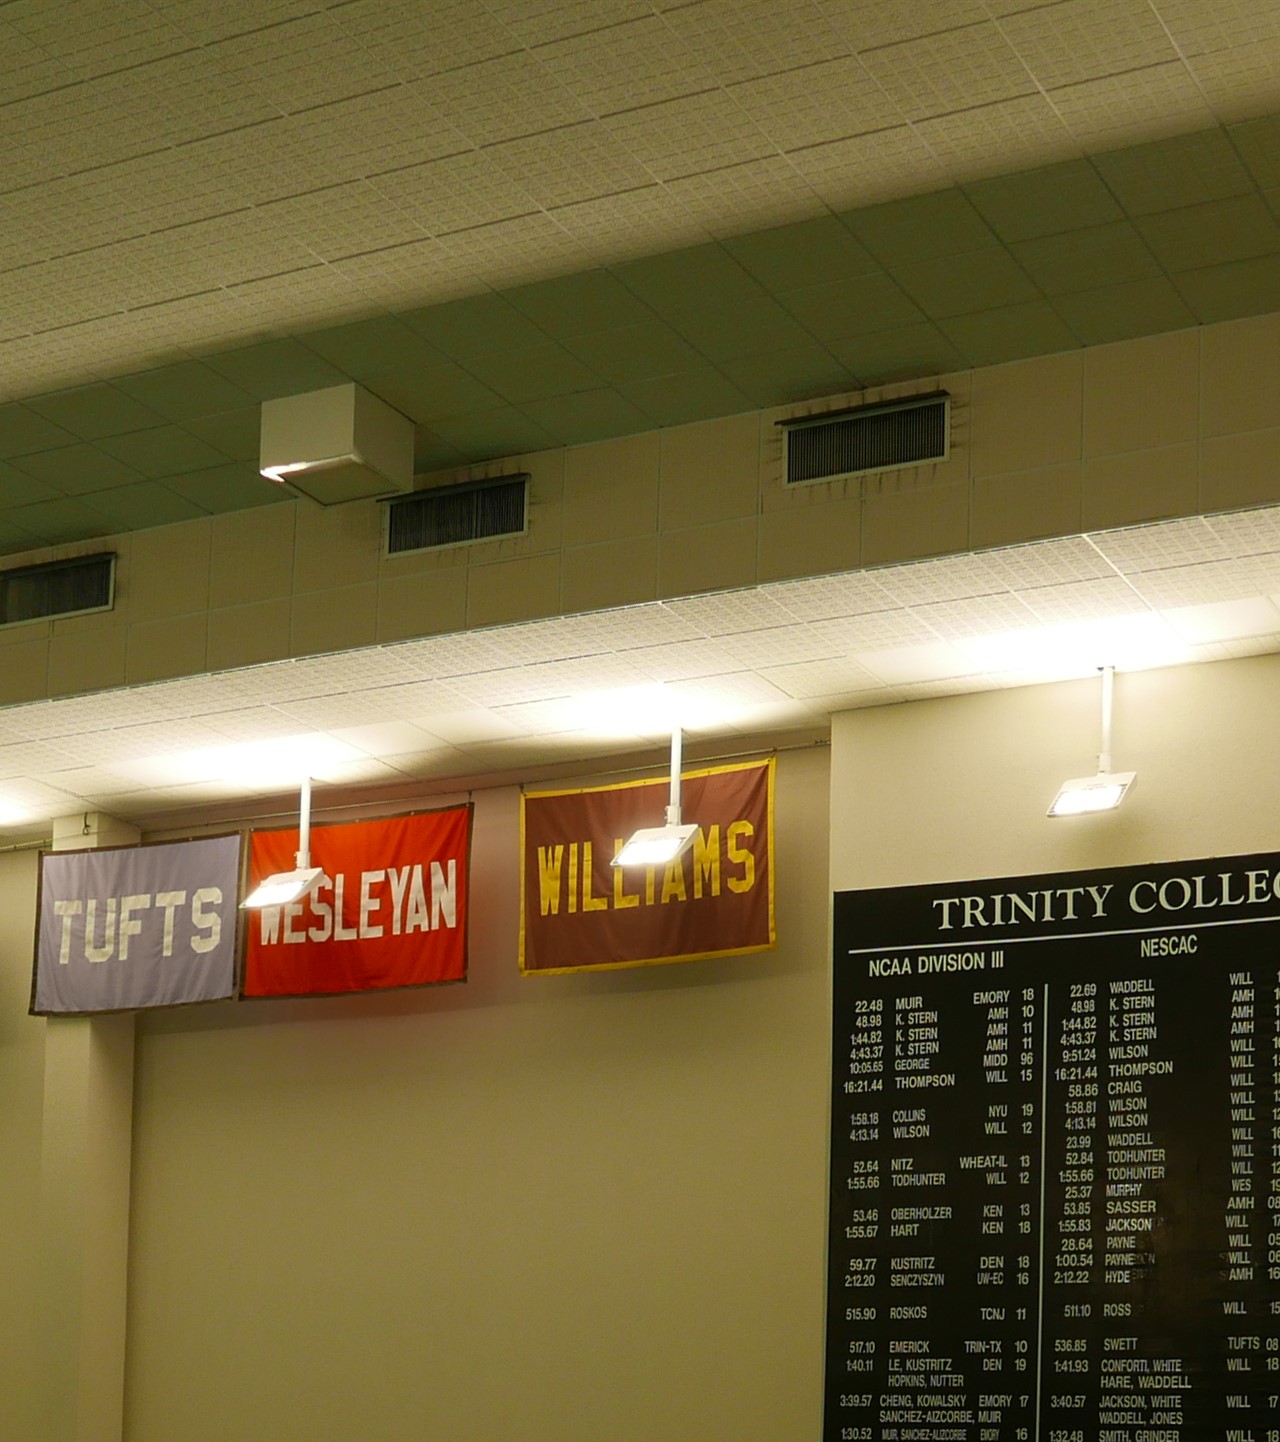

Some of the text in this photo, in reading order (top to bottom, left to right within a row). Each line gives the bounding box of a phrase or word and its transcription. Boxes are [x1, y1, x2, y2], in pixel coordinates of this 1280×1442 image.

[538, 820, 756, 916] WILLIAMS
[257, 859, 458, 946] WESLEYAN
[932, 884, 1114, 930] TRINITY
[54, 887, 222, 964] TUFTS
[1140, 934, 1198, 958] NESCAC
[868, 950, 1004, 978] NCAA DIVISION III
[1070, 983, 1097, 998] 22.69
[1109, 978, 1156, 994] WADDELL
[1229, 971, 1254, 986] WILL
[855, 987, 1035, 1014] 22.48 MUIR EMORY 18
[843, 1068, 1033, 1094] 16:21.44 THOMPSON WILL 15
[1068, 1083, 1099, 1098] 58.86
[1107, 1079, 1143, 1096] CRAIG
[1230, 1073, 1255, 1087] WILL
[853, 1154, 1031, 1174] 52.64 NITZ WHEAT-IL 13
[853, 1203, 1031, 1223] 53.46 OBERHOLZER KEN 13
[1063, 1201, 1091, 1216] 53.85
[1106, 1200, 1157, 1215] SASSER
[1227, 1196, 1255, 1210] AMH
[845, 1305, 1027, 1321] 515.90 ROSKOS TCNJ 11
[1054, 1336, 1279, 1352] 536.85 SWETT TUFTS 08
[1100, 1375, 1193, 1390] HARE, WADDELL
